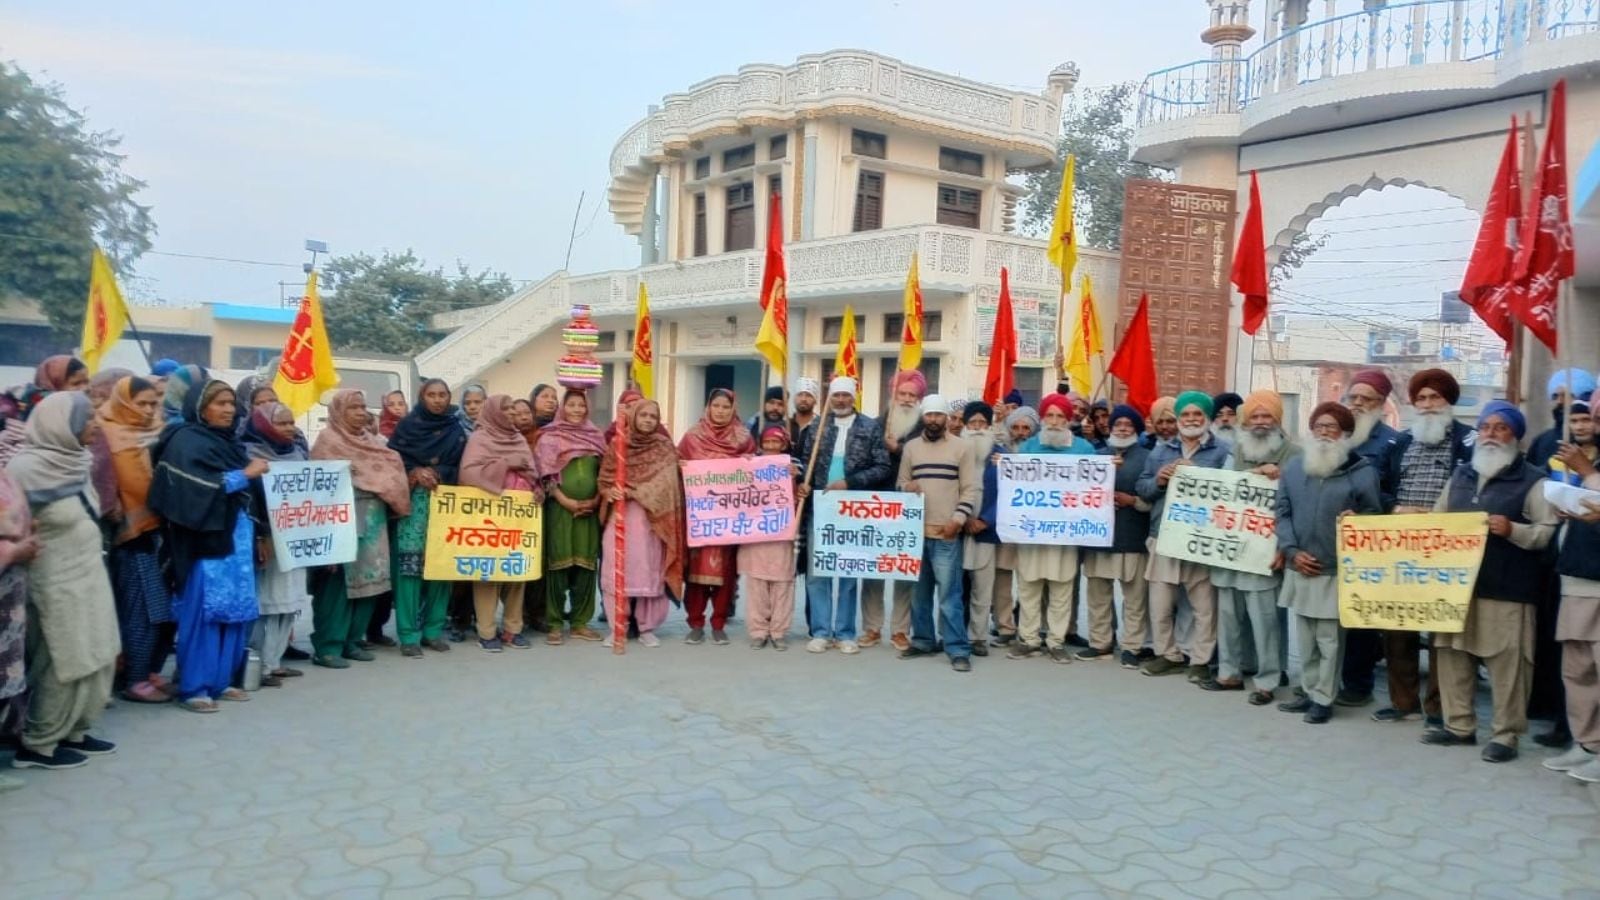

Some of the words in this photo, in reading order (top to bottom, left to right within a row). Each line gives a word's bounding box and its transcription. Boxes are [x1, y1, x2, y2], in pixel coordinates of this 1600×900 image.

[435, 493, 456, 514] ਜੀ
[460, 497, 493, 516] ਰਾਮ
[838, 495, 903, 520] ਮਨਰੇਗਾ
[1010, 487, 1061, 508] 2025
[445, 519, 523, 550] ਮਨਰੇਗਾ
[836, 529, 859, 546] ਰਾਮ
